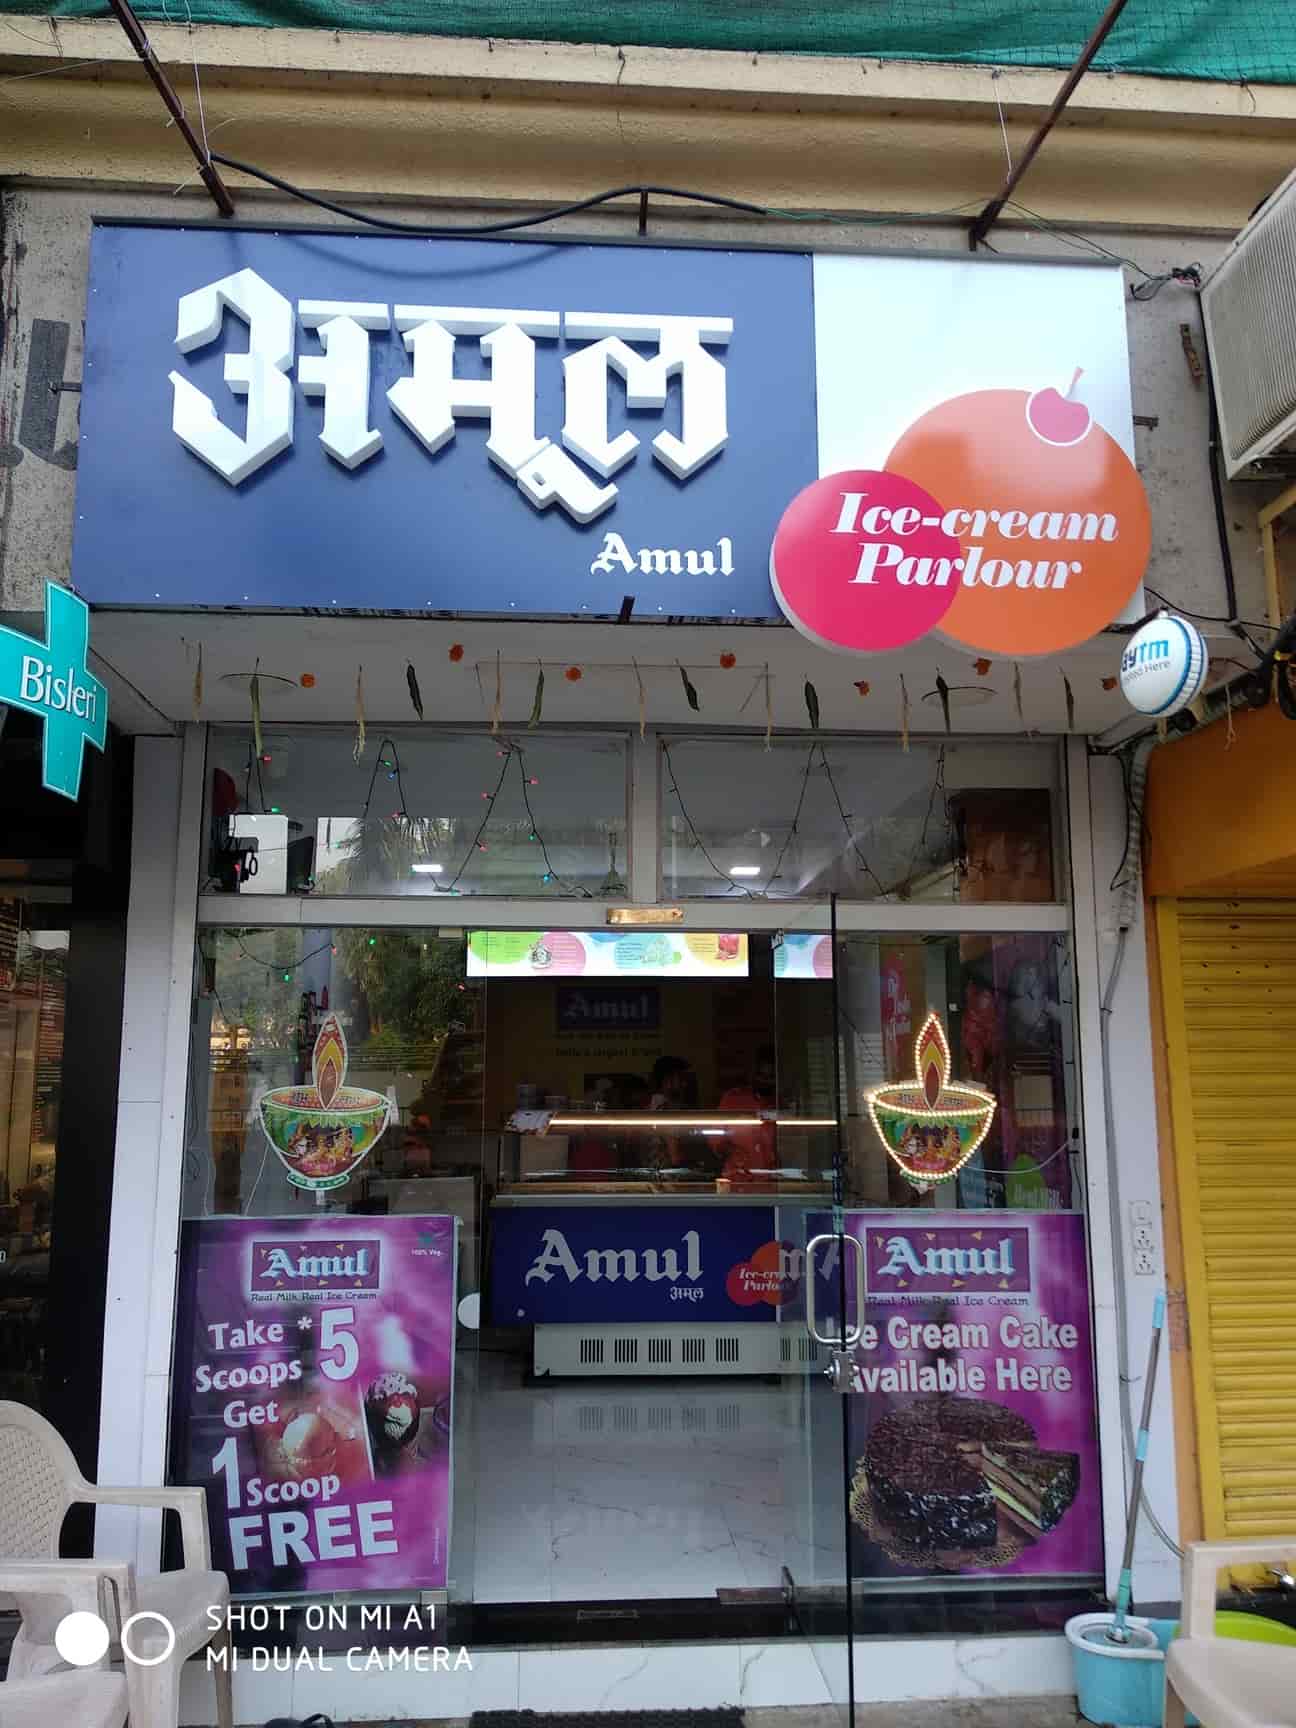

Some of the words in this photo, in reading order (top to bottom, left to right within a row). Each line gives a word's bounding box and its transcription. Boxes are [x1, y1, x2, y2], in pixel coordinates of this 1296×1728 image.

[168, 267, 734, 524] अमूल
[829, 491, 1119, 543] Ice-cream
[590, 532, 735, 576] Amul
[848, 541, 1083, 591] Parlour
[20, 655, 98, 723] Bisleri
[259, 1247, 370, 1278] Amul
[525, 1229, 704, 1287] Amul
[877, 1236, 1016, 1276] Amul
[251, 1293, 273, 1302] Real
[276, 1293, 298, 1302] Milk
[302, 1292, 324, 1301] Real
[327, 1291, 343, 1300] Ice
[345, 1291, 377, 1300] Cream
[965, 1296, 985, 1306] Ice
[988, 1296, 1030, 1306] Cream
[208, 1320, 285, 1350] Take
[887, 1316, 990, 1351] Cream
[1000, 1315, 1079, 1350] Cake
[196, 1359, 302, 1393] Scoops
[996, 1358, 1074, 1392] Here
[223, 1400, 280, 1429] Get
[212, 1437, 241, 1509] 1
[247, 1474, 340, 1506] Scoop
[228, 1500, 399, 1571] FREE
